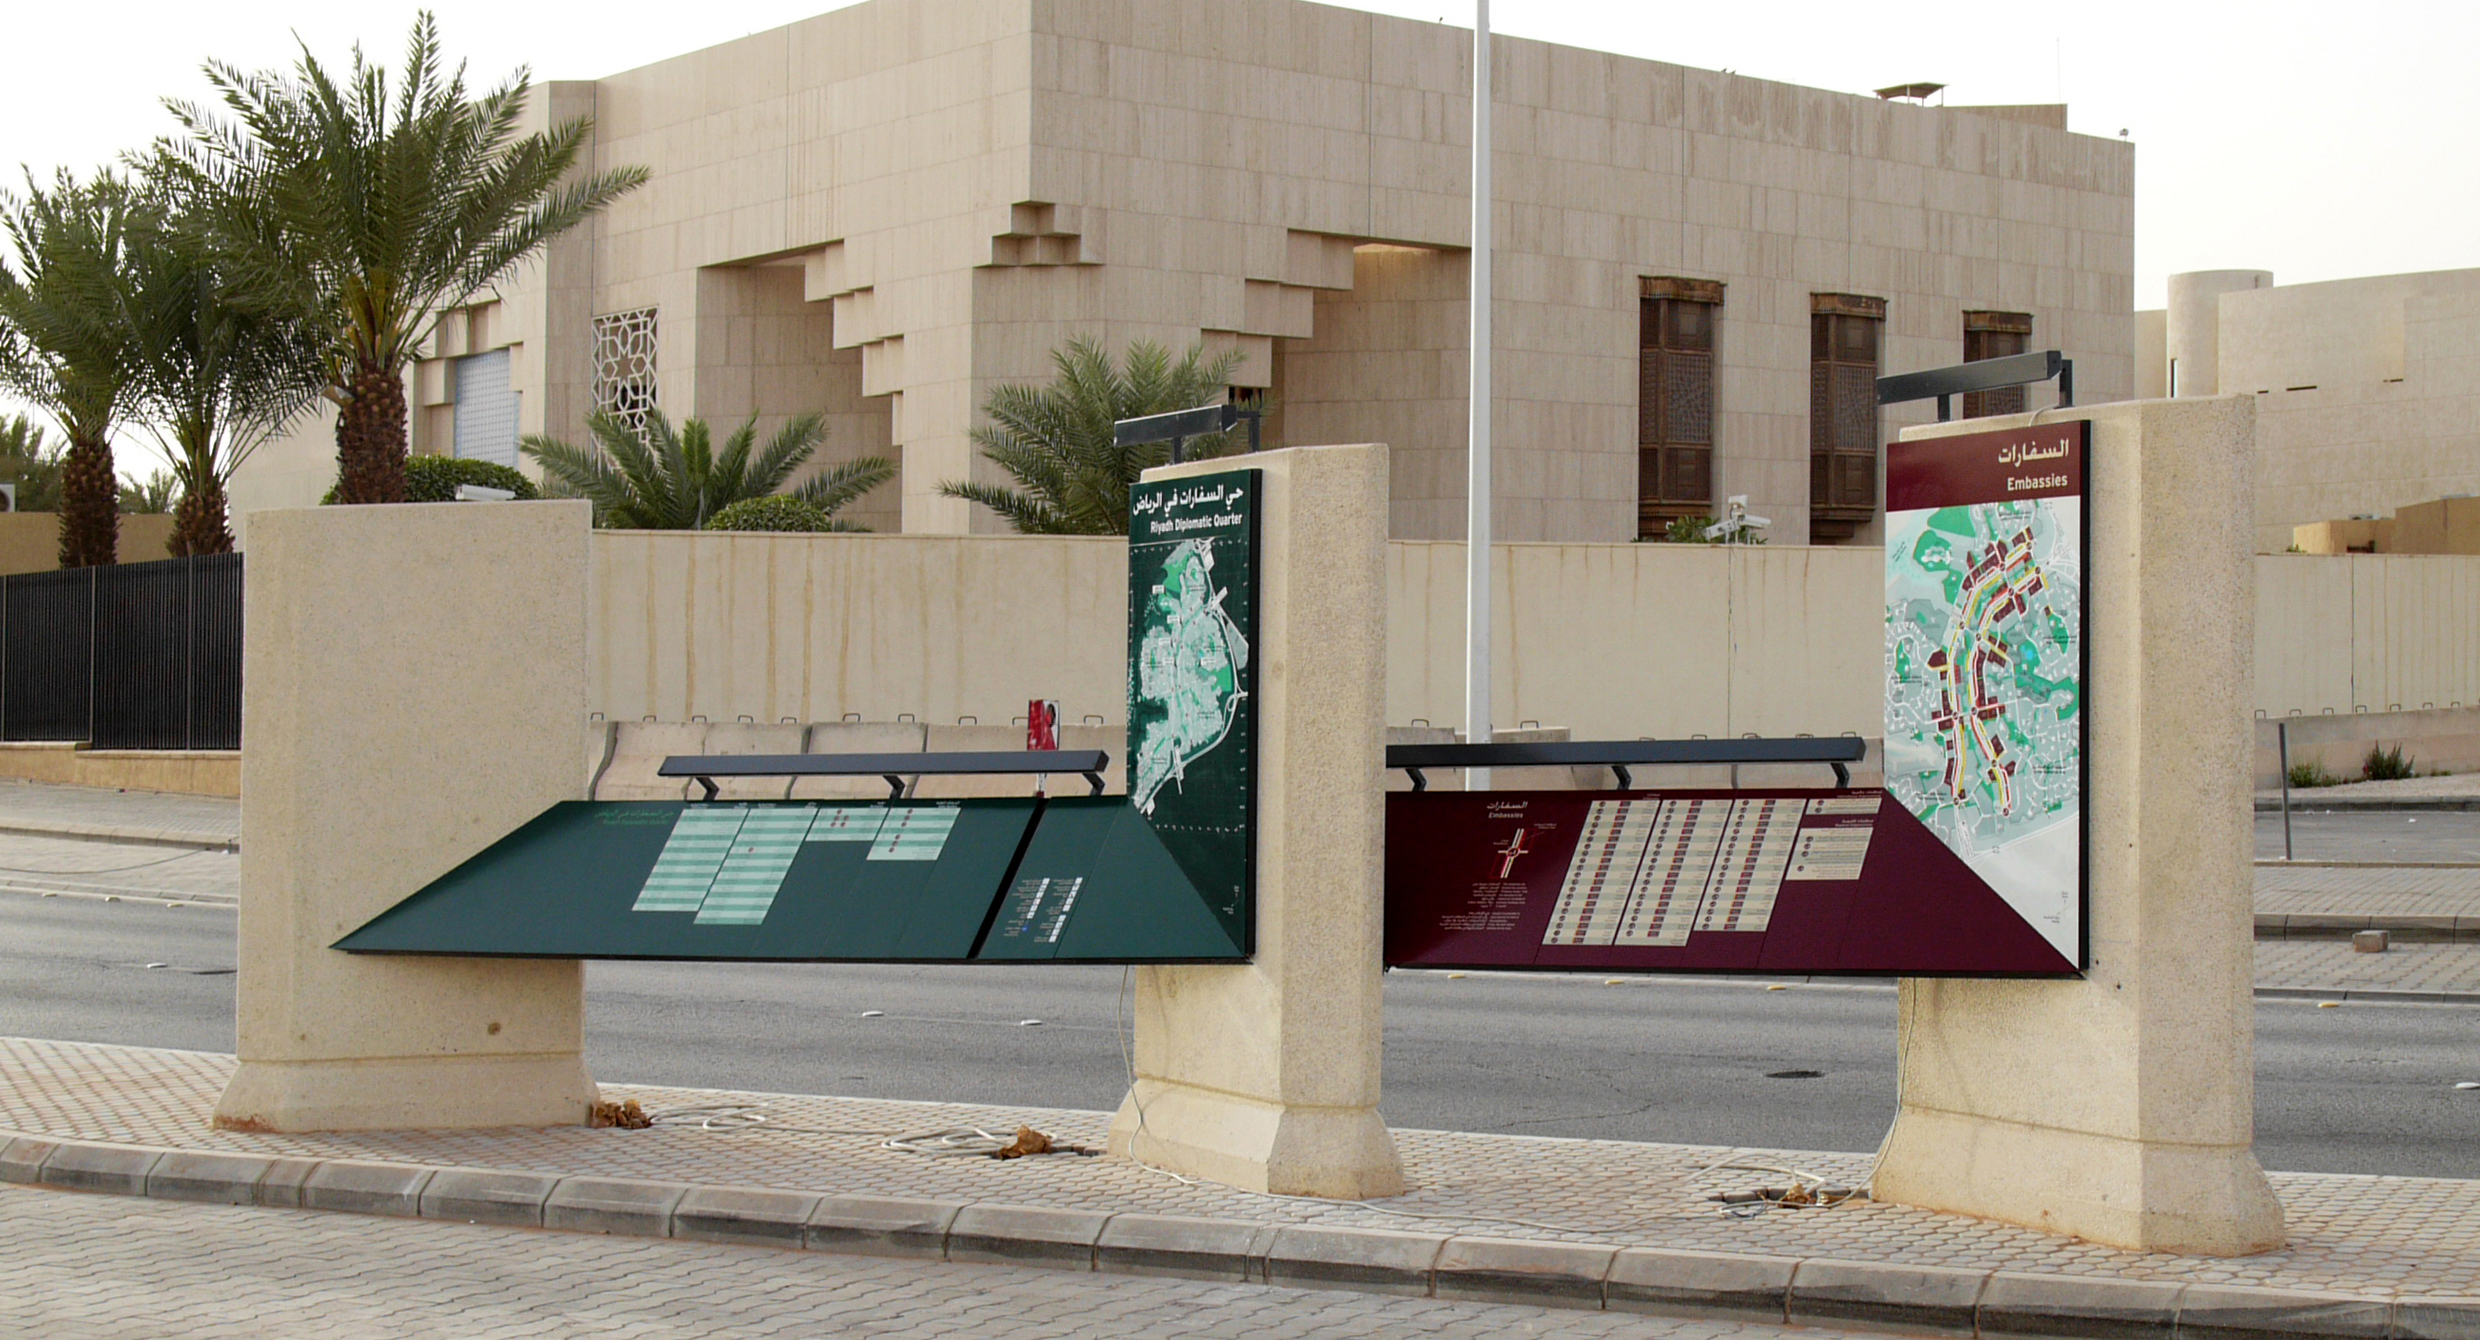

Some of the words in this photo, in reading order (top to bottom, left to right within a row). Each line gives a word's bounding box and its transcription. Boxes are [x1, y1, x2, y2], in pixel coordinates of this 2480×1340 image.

[1998, 438, 2070, 467] السفارات
[2007, 473, 2068, 491] Embassies
[1133, 491, 1163, 516] الرياض
[1164, 487, 1178, 517] في
[1180, 484, 1224, 509] السفارات
[1225, 487, 1244, 511] حي
[1150, 520, 1174, 535] Riyadh
[1175, 515, 1213, 532] Diplomatic
[1213, 513, 1243, 528] Quarter
